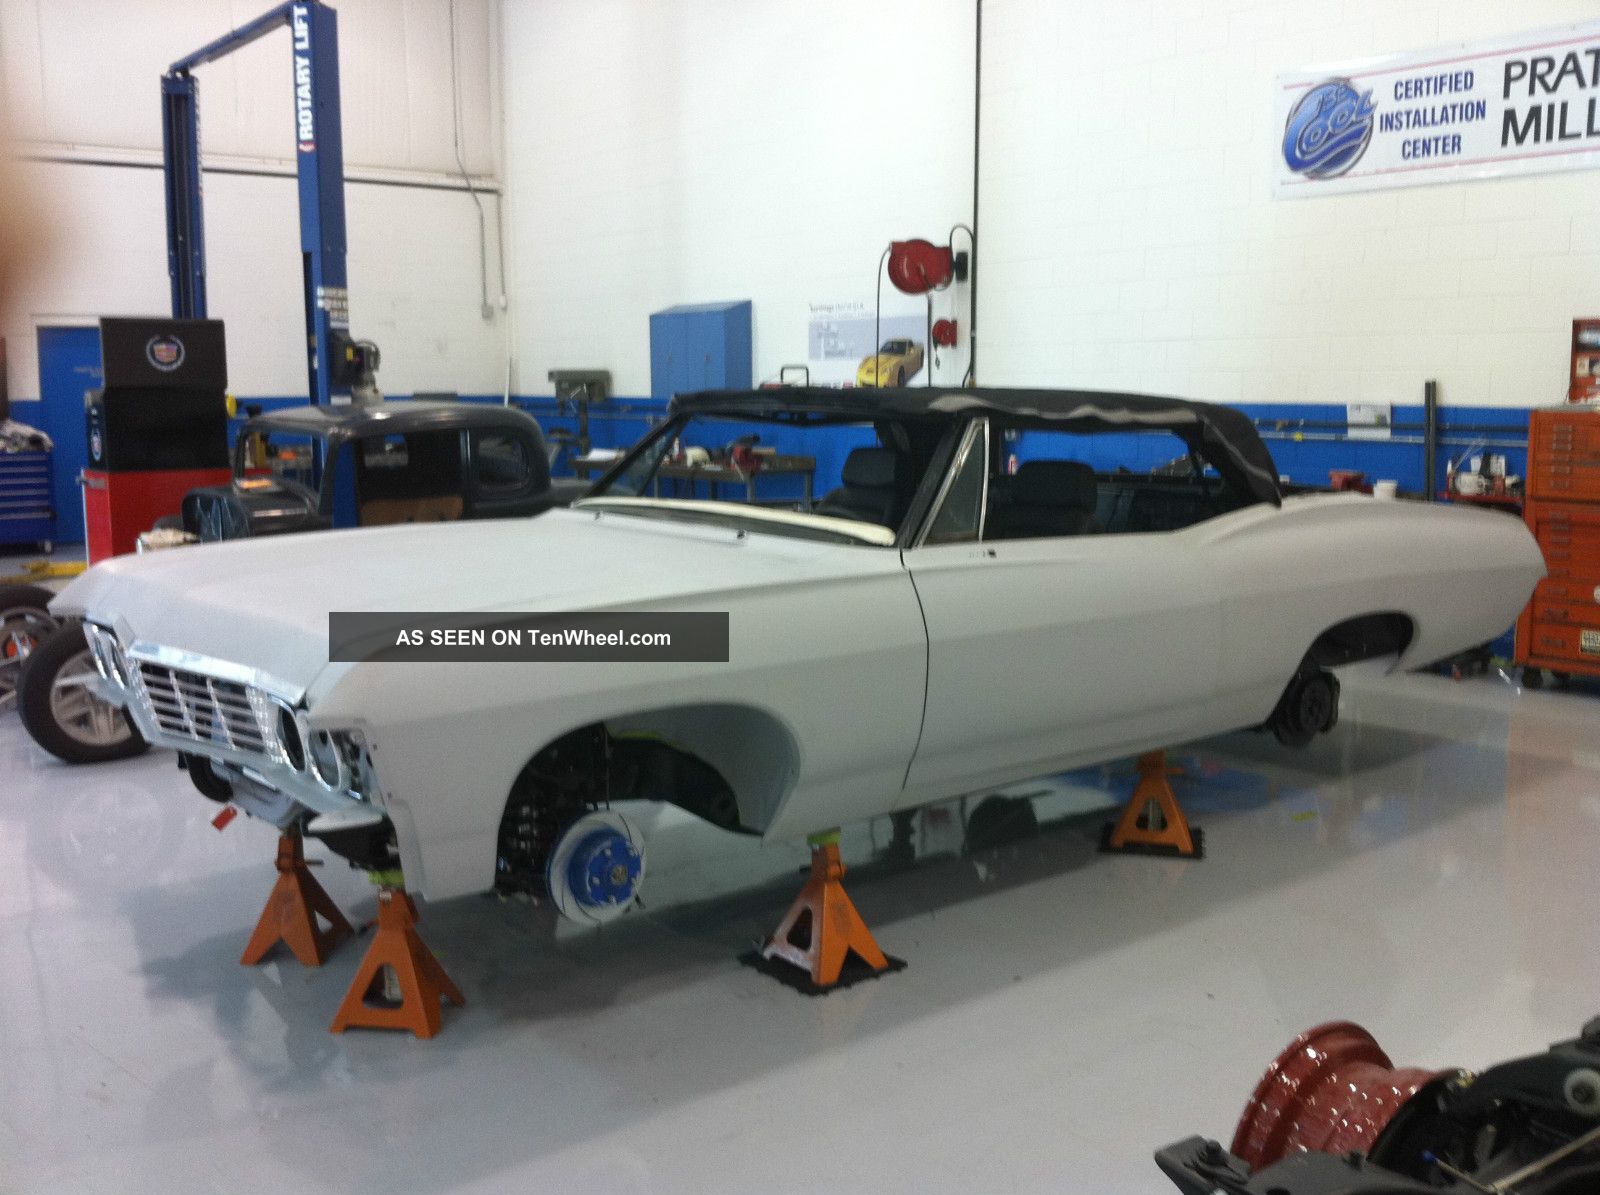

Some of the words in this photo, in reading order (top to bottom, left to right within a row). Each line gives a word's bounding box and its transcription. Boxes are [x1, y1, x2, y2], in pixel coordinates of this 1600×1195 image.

[292, 4, 310, 51] LIFT
[1394, 70, 1475, 102] CERTIFIED
[1503, 47, 1600, 100] PRAT
[296, 56, 313, 141] ROTARY
[1379, 99, 1487, 133] INSTALLATION
[1501, 96, 1600, 148] MILL
[1401, 133, 1462, 160] CENTER
